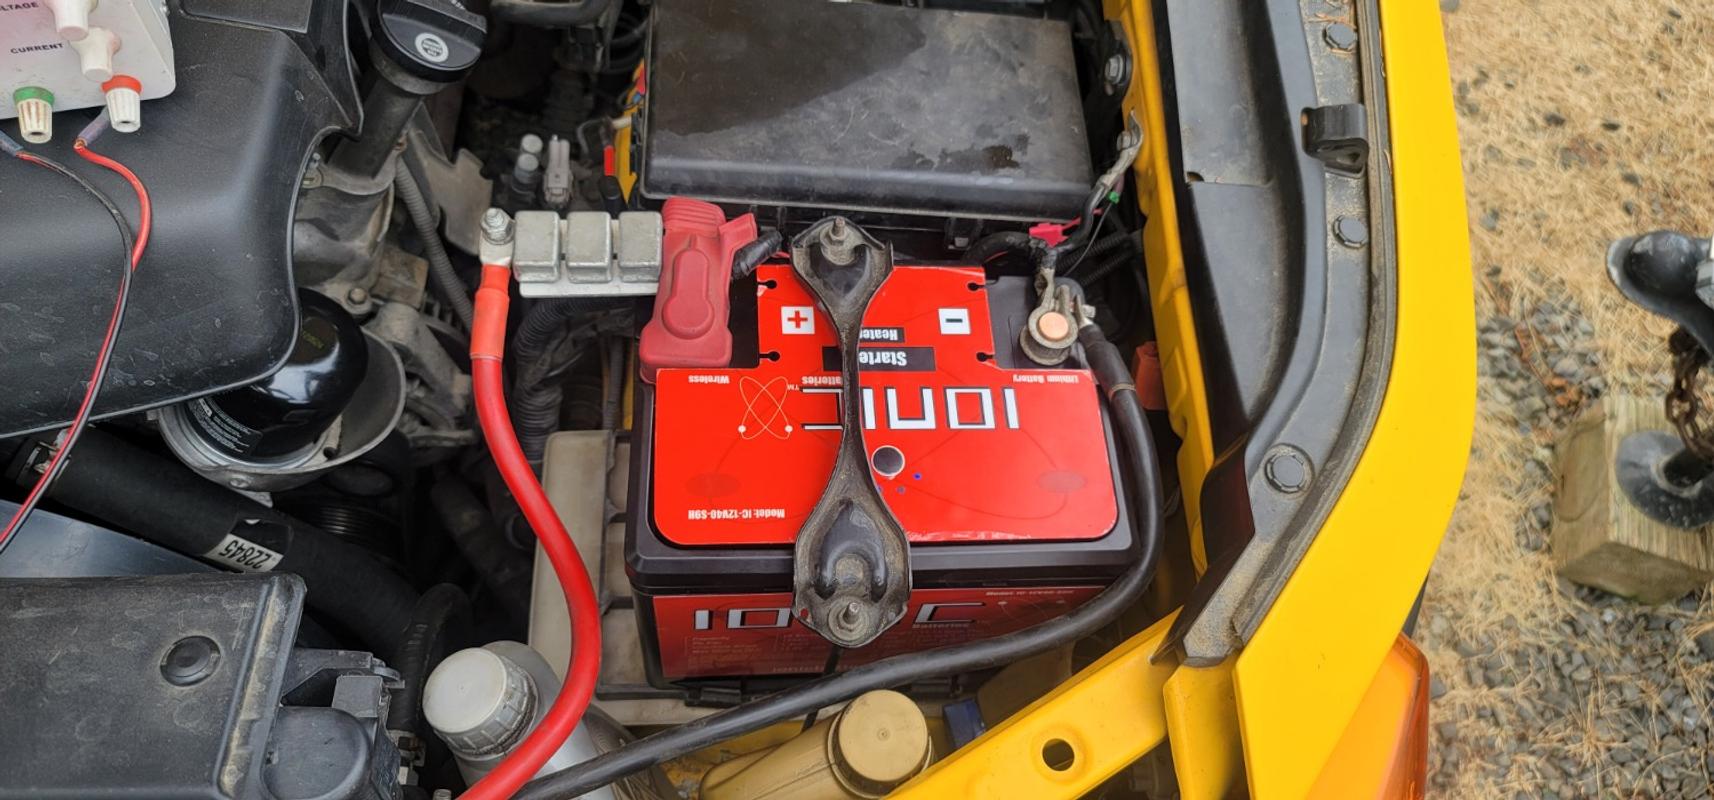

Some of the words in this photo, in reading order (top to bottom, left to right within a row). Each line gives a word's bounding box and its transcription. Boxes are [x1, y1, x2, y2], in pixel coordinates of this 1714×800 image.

[0, 2, 39, 11] LTAGE
[10, 42, 64, 54] CURRENT
[859, 351, 907, 366] Starte
[688, 374, 730, 384] Wireless
[801, 376, 842, 386] atteries
[1013, 374, 1045, 383] Battery
[1047, 375, 1079, 383] Lithium
[803, 386, 1018, 430] IONIC
[688, 508, 752, 520] IC-12V40-S9H
[754, 508, 785, 519] Model:
[218, 540, 273, 569] 22845
